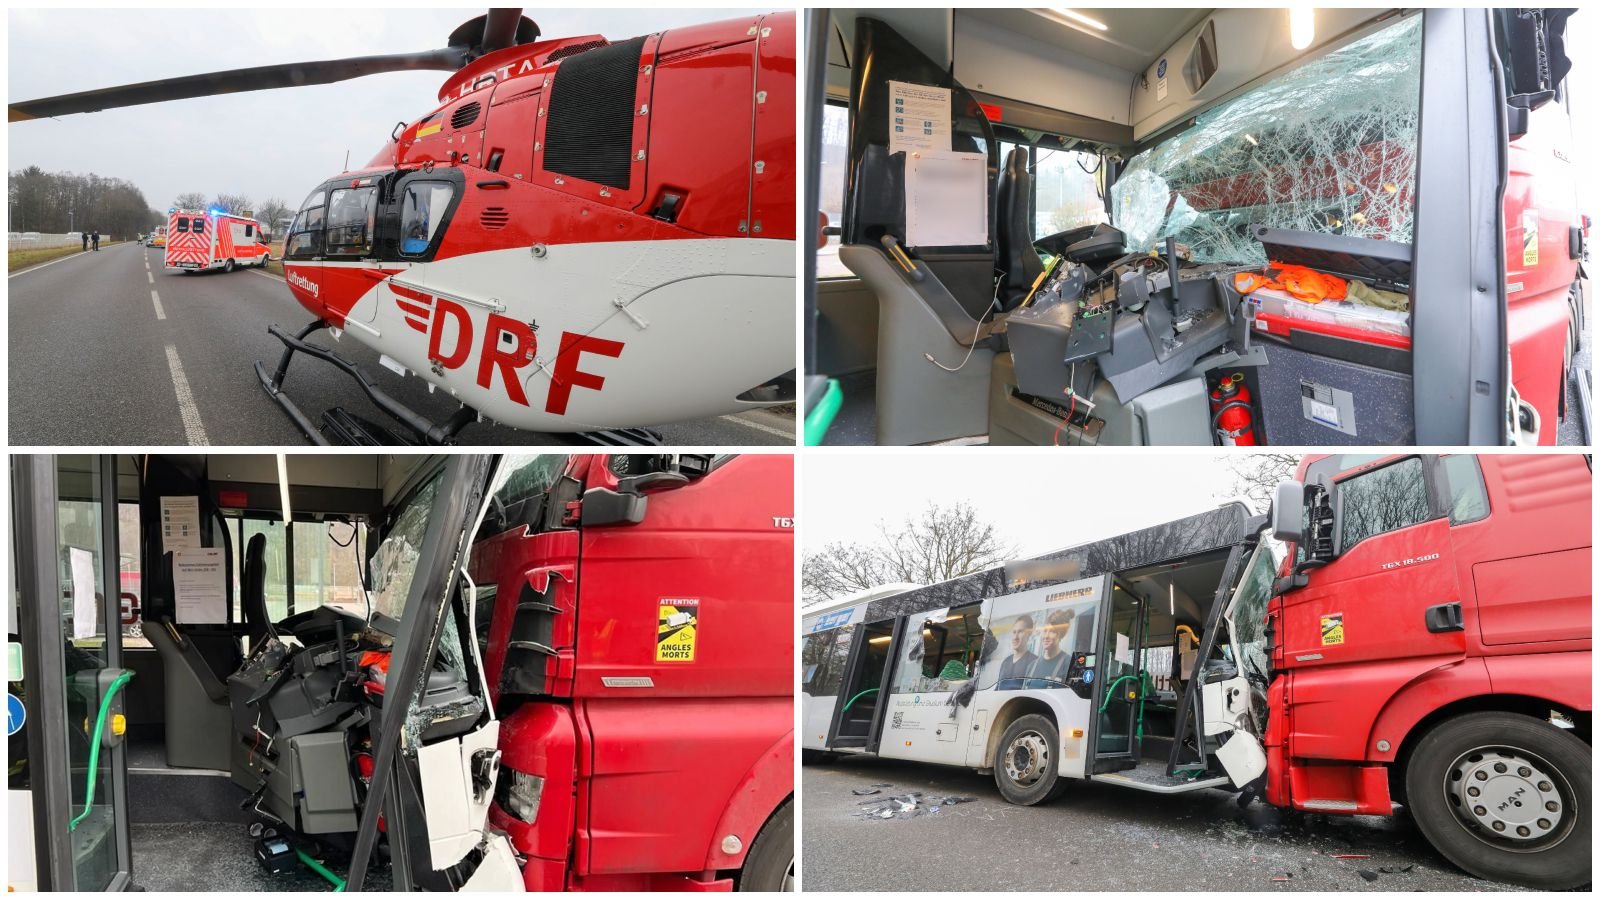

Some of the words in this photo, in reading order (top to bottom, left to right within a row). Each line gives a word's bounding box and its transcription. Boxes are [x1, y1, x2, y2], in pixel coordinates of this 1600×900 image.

[288, 269, 319, 298] Luftrettung
[428, 297, 625, 416] DRF
[1032, 397, 1069, 419] Mercedes-Ben
[660, 598, 699, 606] ATTENTION
[1045, 586, 1093, 602] LIEBHERR
[662, 651, 690, 659] MORTS
[1498, 787, 1526, 811] MAN
